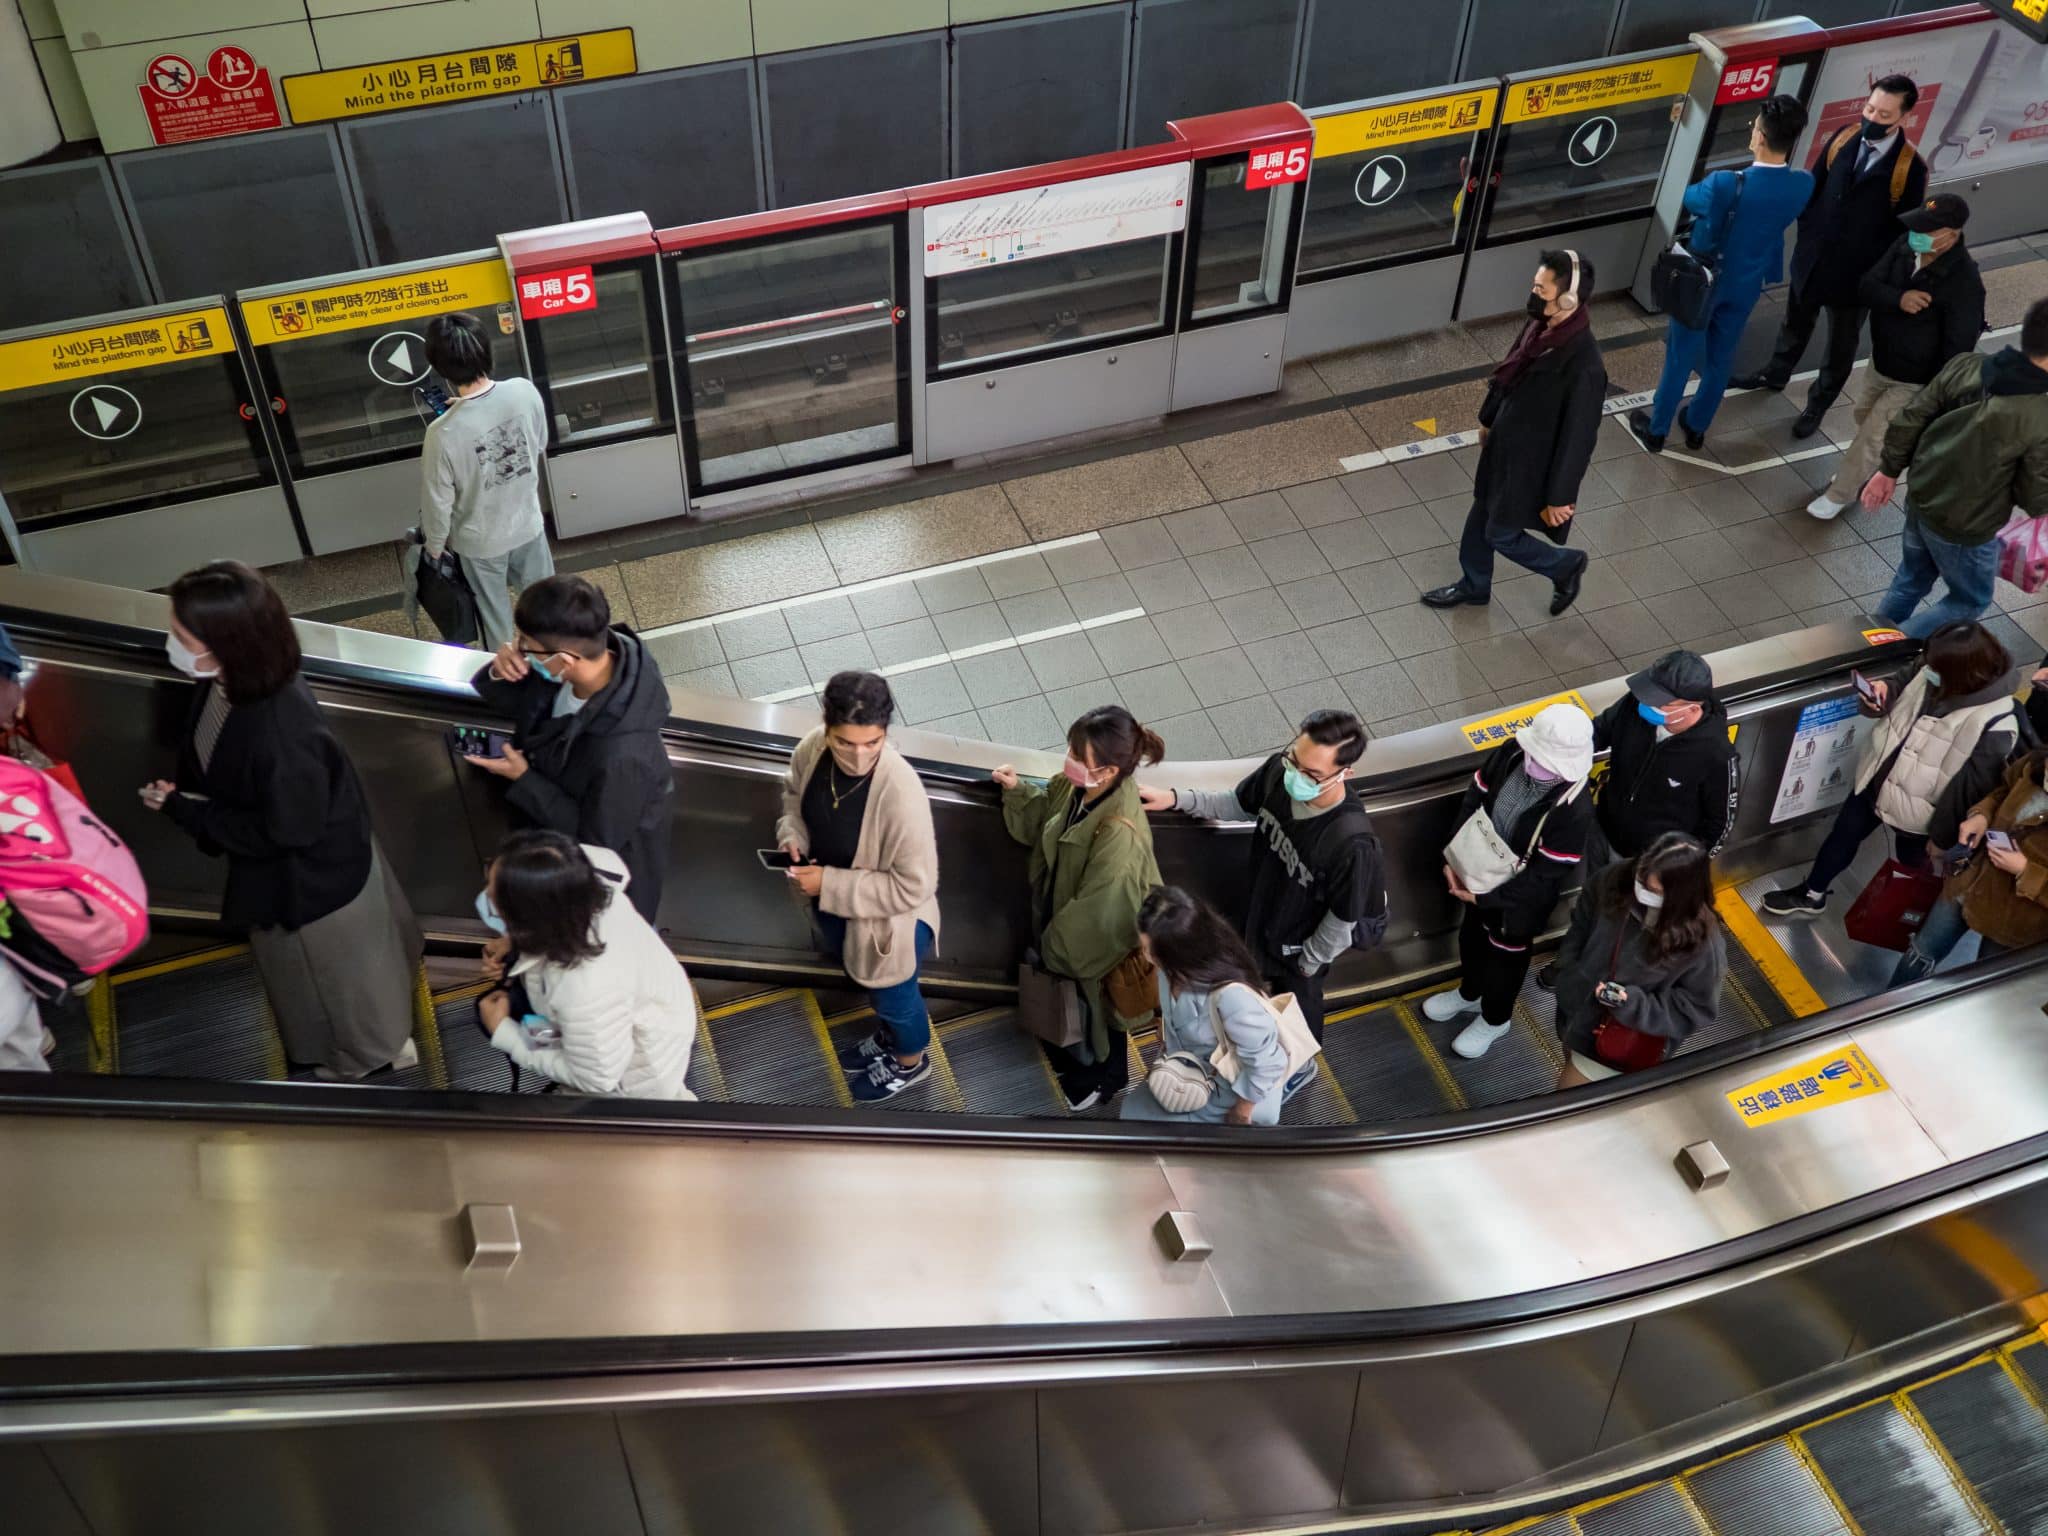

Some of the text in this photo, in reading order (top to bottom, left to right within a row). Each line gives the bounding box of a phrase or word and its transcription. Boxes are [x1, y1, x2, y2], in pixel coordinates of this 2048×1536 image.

[362, 53, 518, 92] 小心月台間隙
[1750, 65, 1773, 92] 5
[345, 74, 521, 109] Mind the platform gap
[1732, 87, 1749, 96] Car
[1365, 129, 1385, 140] Mind
[1386, 127, 1399, 136] the
[1399, 121, 1431, 136] platform
[1370, 105, 1449, 130] 小心月台間隙
[1251, 147, 1307, 176] 車廂 5
[1264, 170, 1283, 180] Car
[312, 279, 449, 315] 關門時勿強行進出
[522, 273, 591, 304] 車廂 5
[315, 292, 469, 325] Please stay clear of closing doors
[542, 298, 566, 309] Car
[52, 329, 162, 360] 小心月台間隙
[53, 344, 167, 371] Mind the platform gap
[1614, 394, 1649, 409] Line
[1258, 807, 1315, 888] TUSSY
